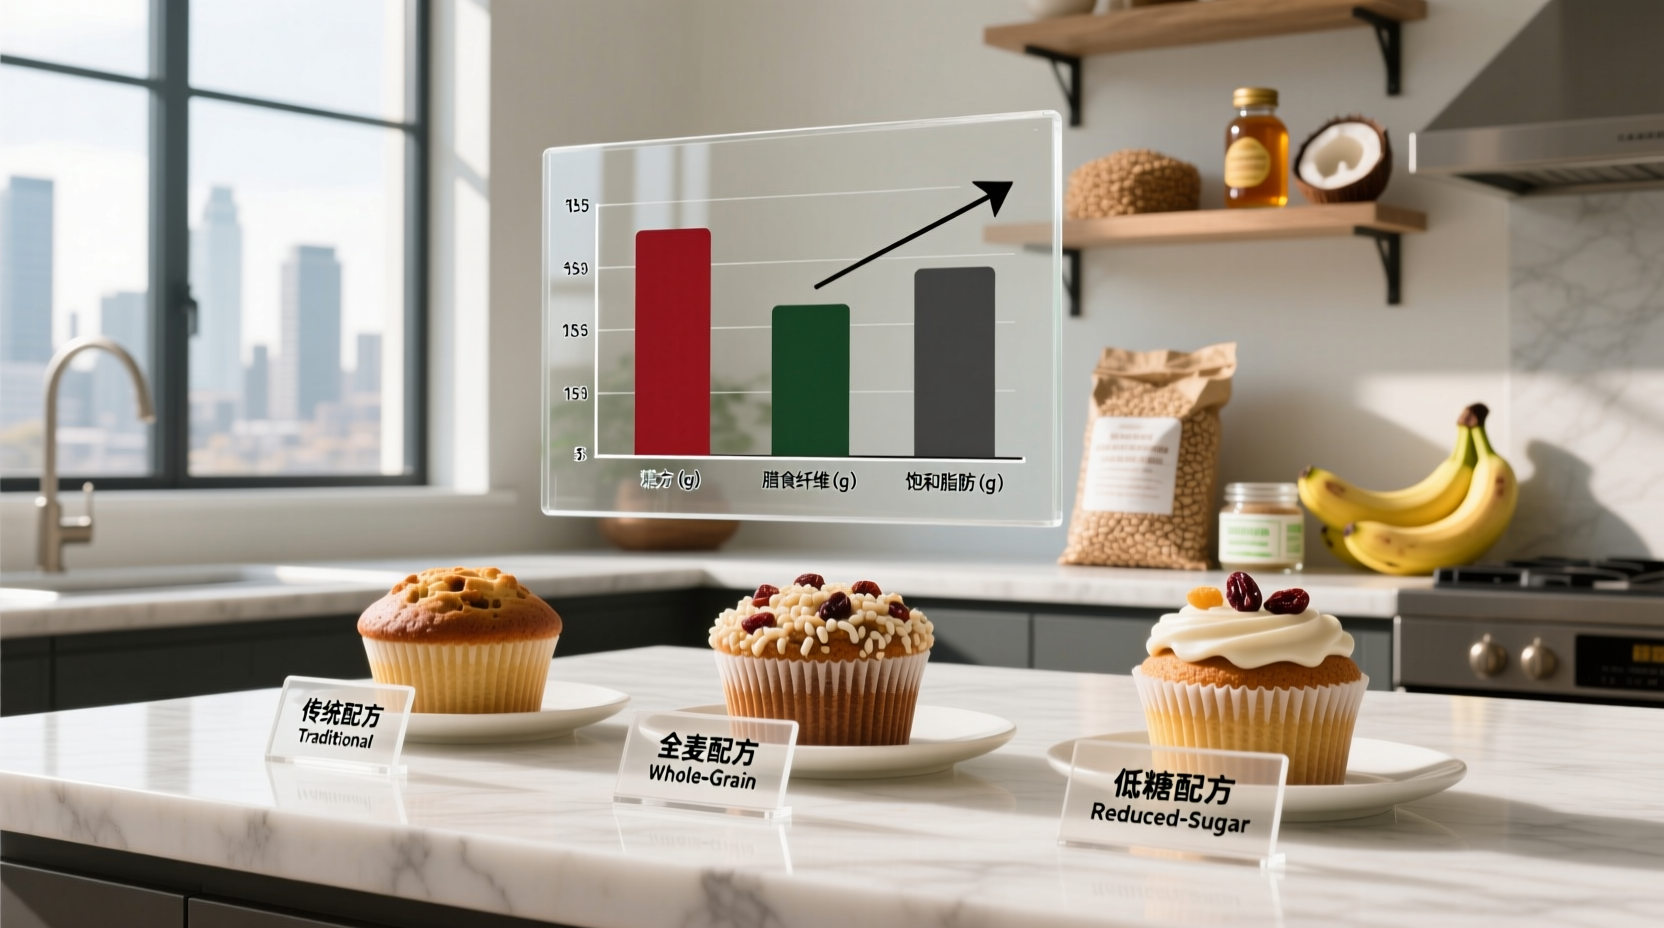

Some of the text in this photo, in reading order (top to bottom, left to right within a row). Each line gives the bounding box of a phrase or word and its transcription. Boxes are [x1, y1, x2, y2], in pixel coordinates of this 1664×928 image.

[302, 697, 384, 728] 传统配方
[299, 728, 374, 749] Traditional
[657, 731, 759, 766] 全麦配方
[650, 764, 757, 790] Whole-Grain
[1114, 768, 1236, 805] 低糖配方
[1090, 802, 1250, 837] Reduced-Sugar
